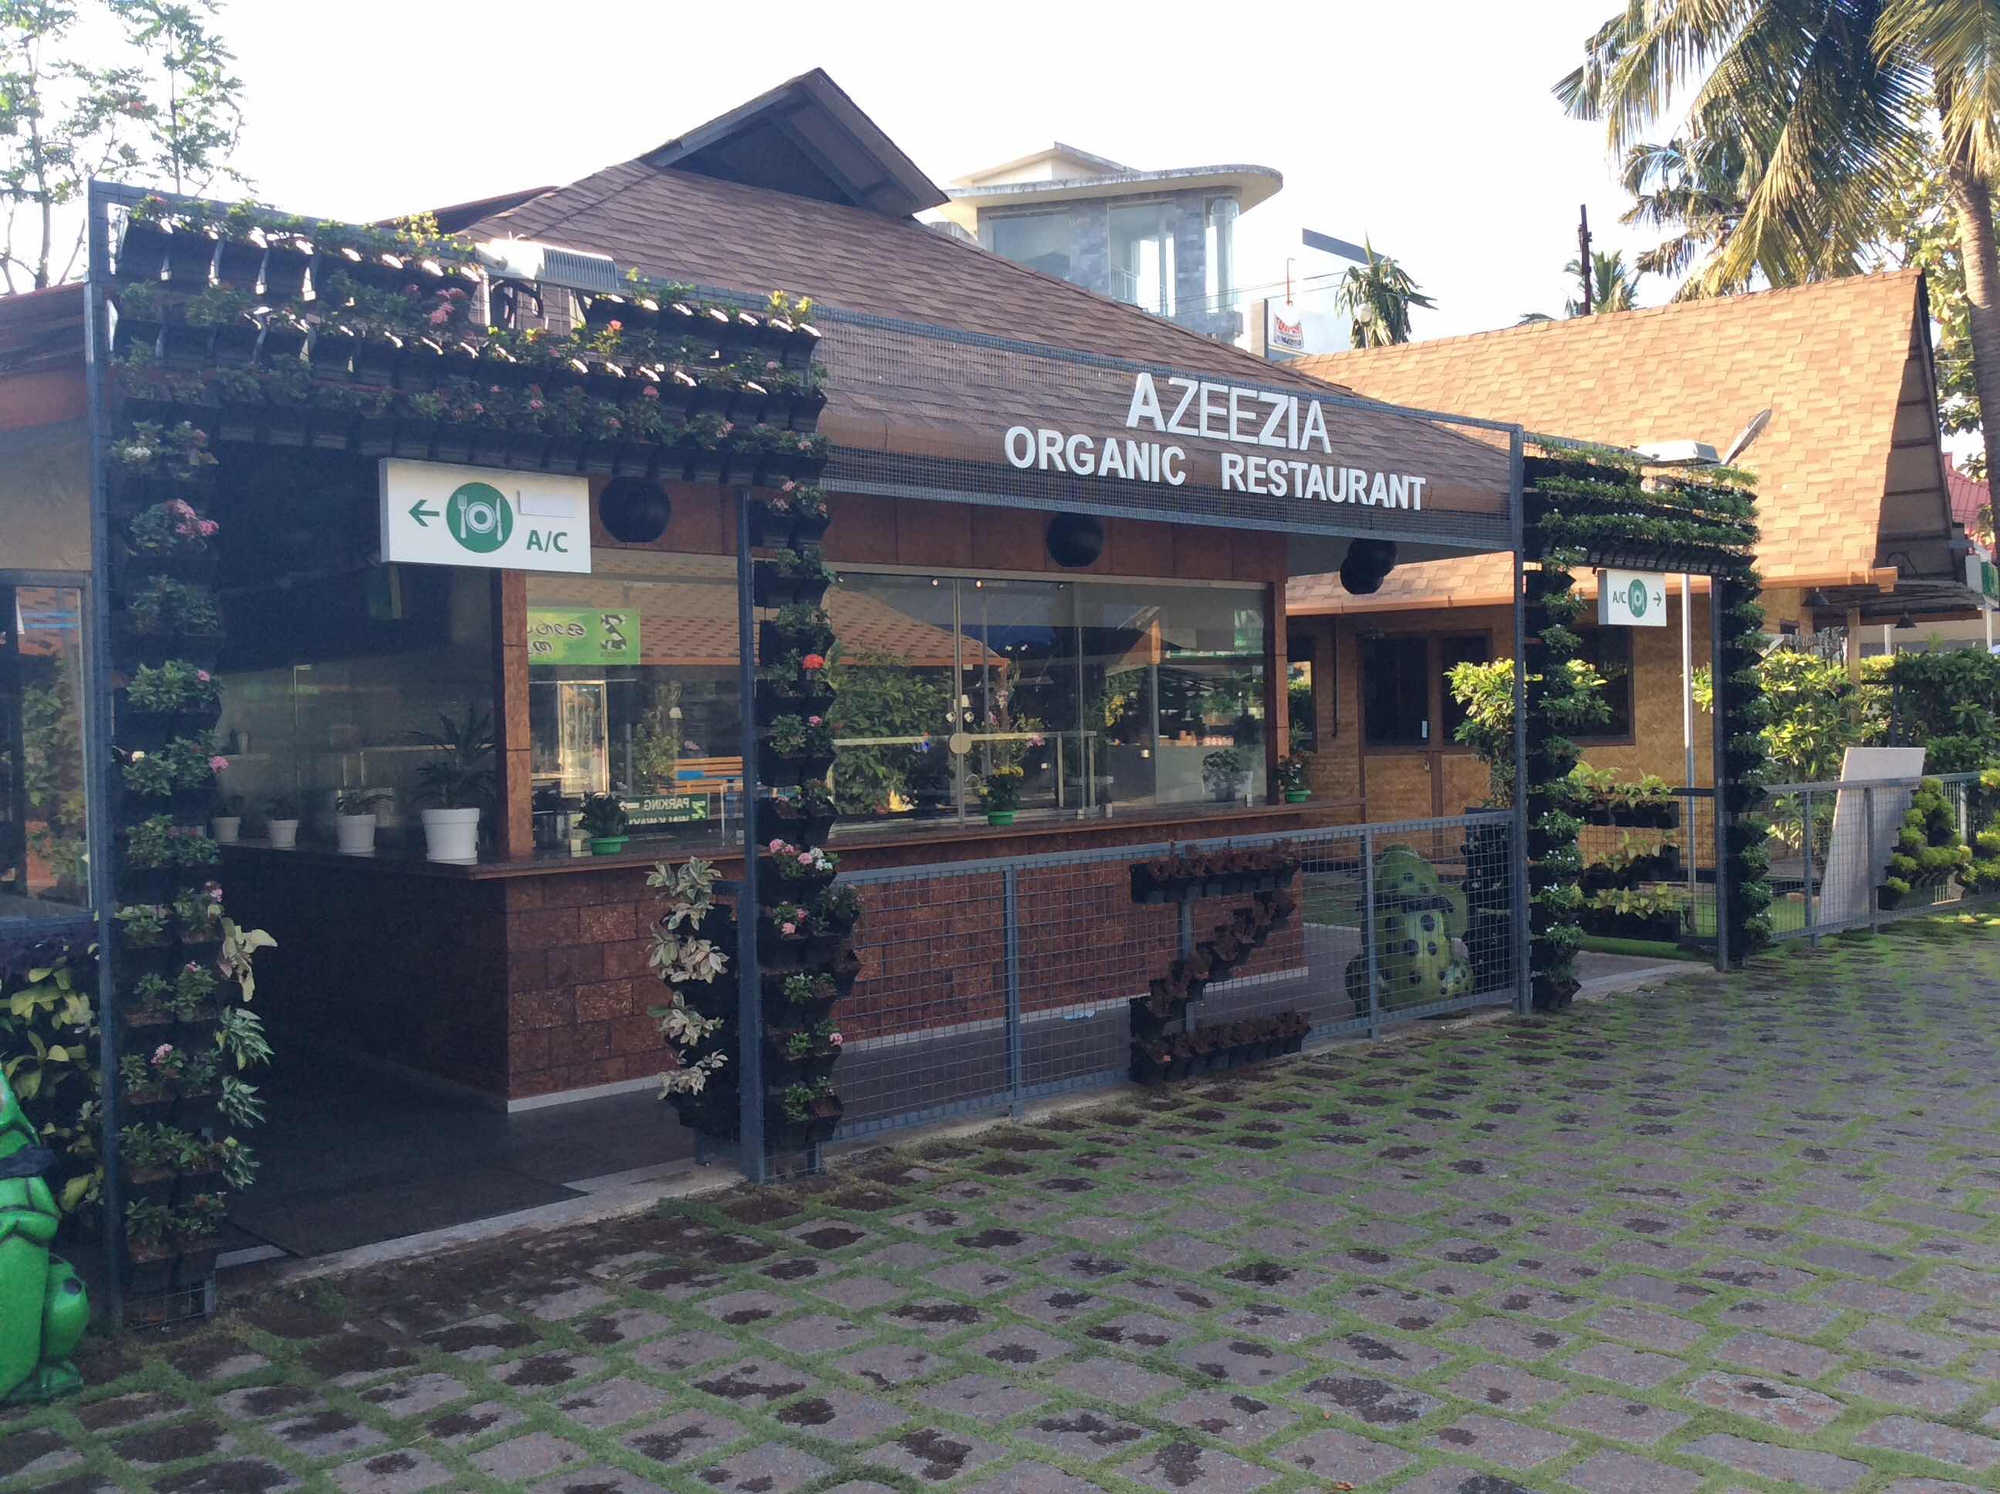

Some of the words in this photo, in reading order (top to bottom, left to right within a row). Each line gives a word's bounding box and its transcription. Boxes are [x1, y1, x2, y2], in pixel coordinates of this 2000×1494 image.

[1126, 372, 1332, 454] AZEEZIA
[1004, 425, 1186, 486] ORGANIC
[1221, 452, 1427, 511] RESTAURANT
[526, 529, 569, 553] A/C
